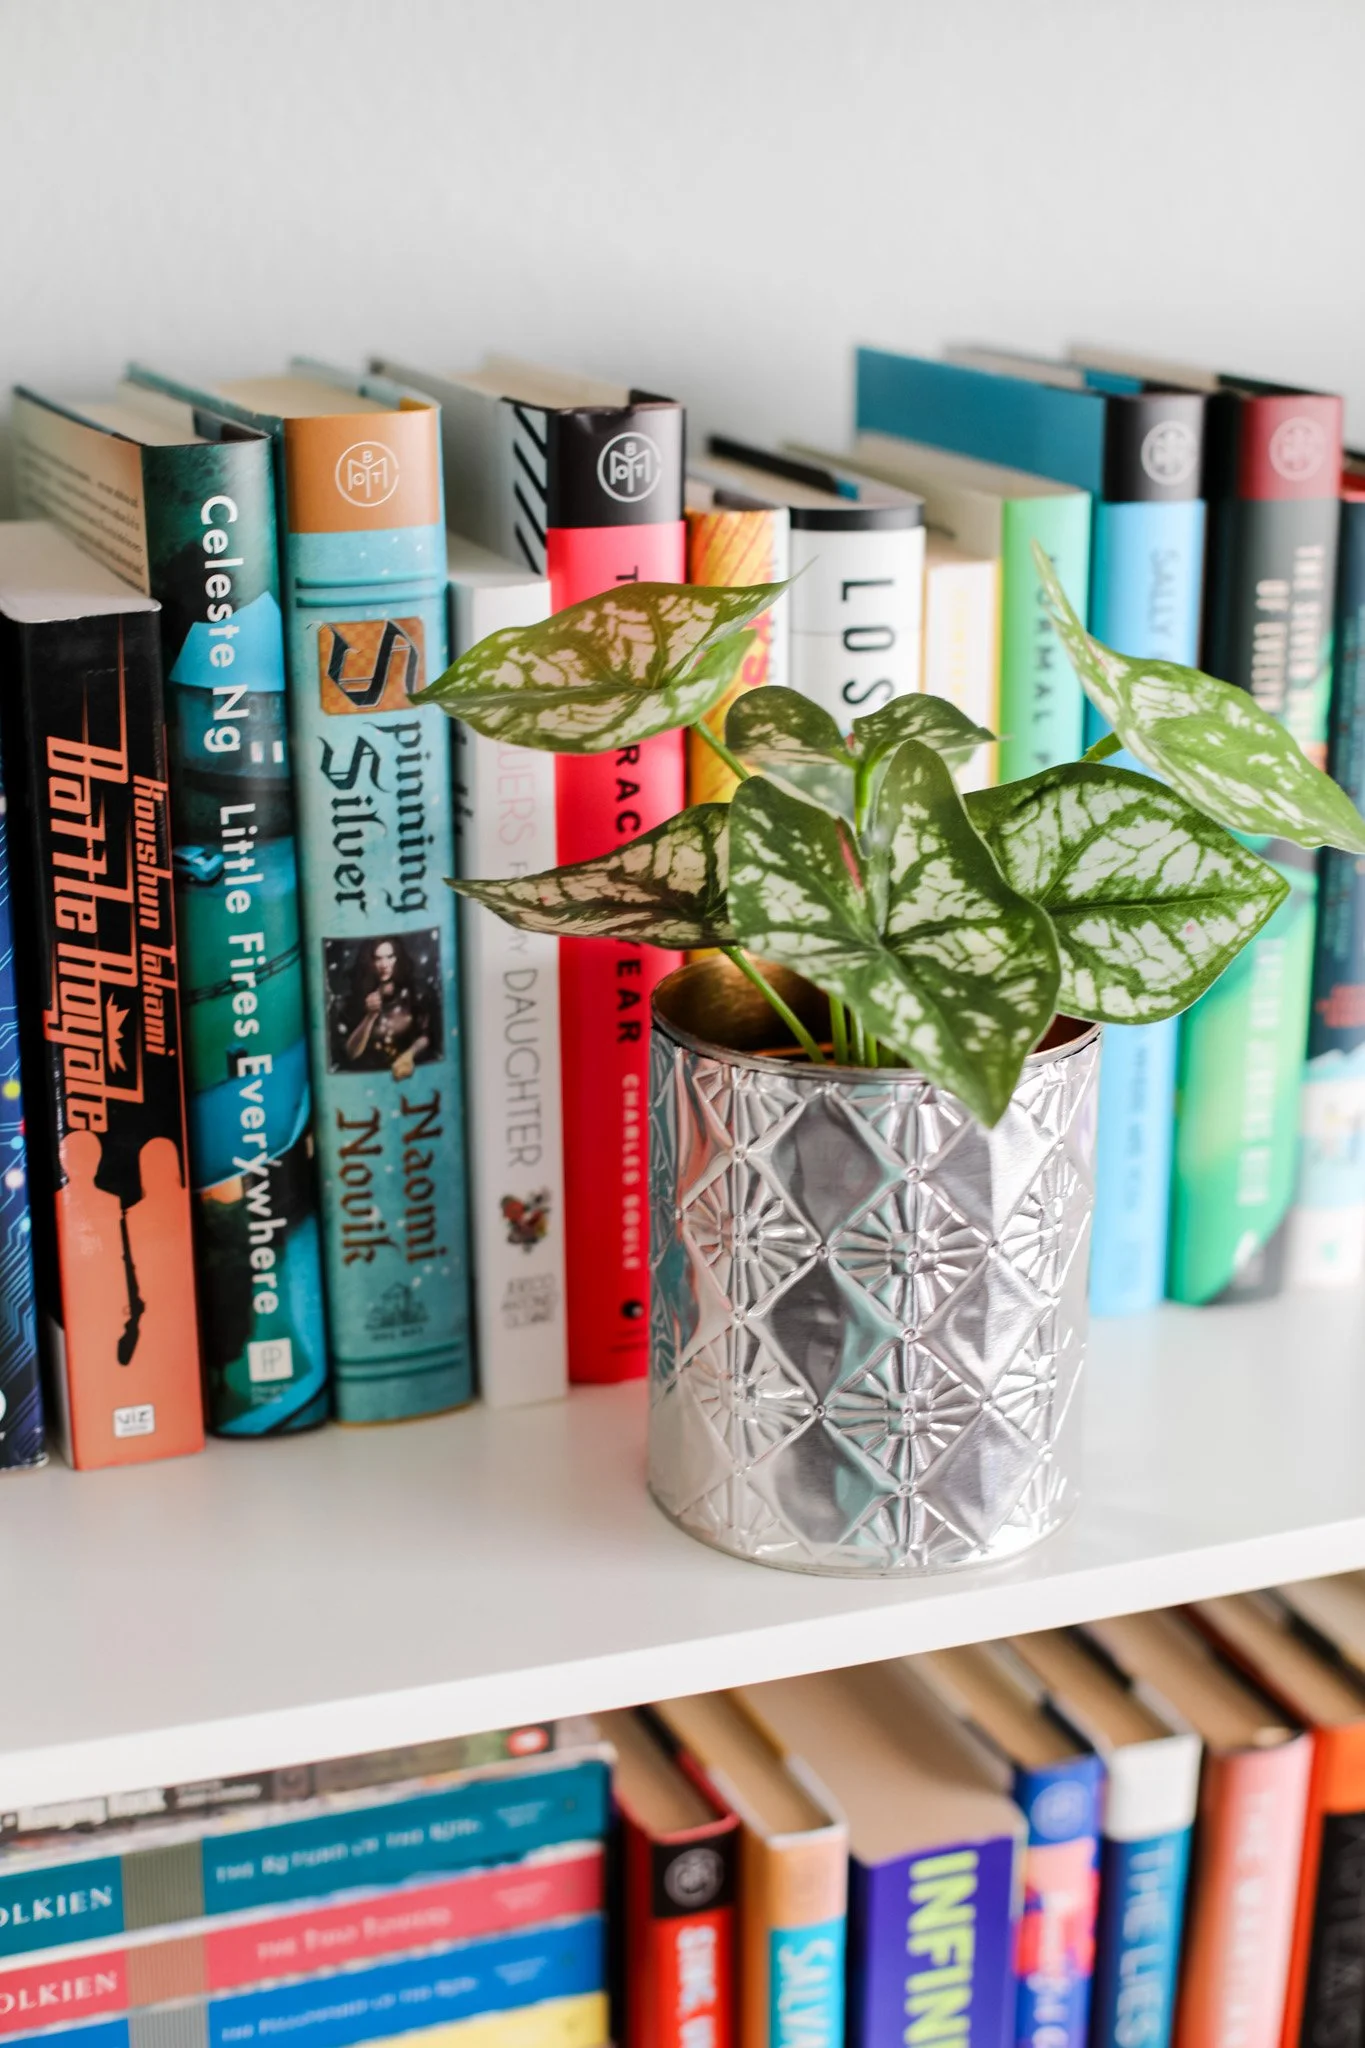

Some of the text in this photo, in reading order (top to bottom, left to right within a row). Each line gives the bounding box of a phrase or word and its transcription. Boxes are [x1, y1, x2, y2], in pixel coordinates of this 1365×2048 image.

[132, 773, 177, 1057] Koushun Takami
[200, 495, 288, 1315] Celeste Ng Little Fires Everywhere
[317, 735, 393, 919] Silver
[43, 735, 144, 1133] Battle Royale
[501, 967, 543, 1168] DAUGHTER
[335, 1106, 400, 1266] Novik
[400, 1088, 448, 1265] Naomi
[621, 1073, 642, 1271] CHARLES SOULE
